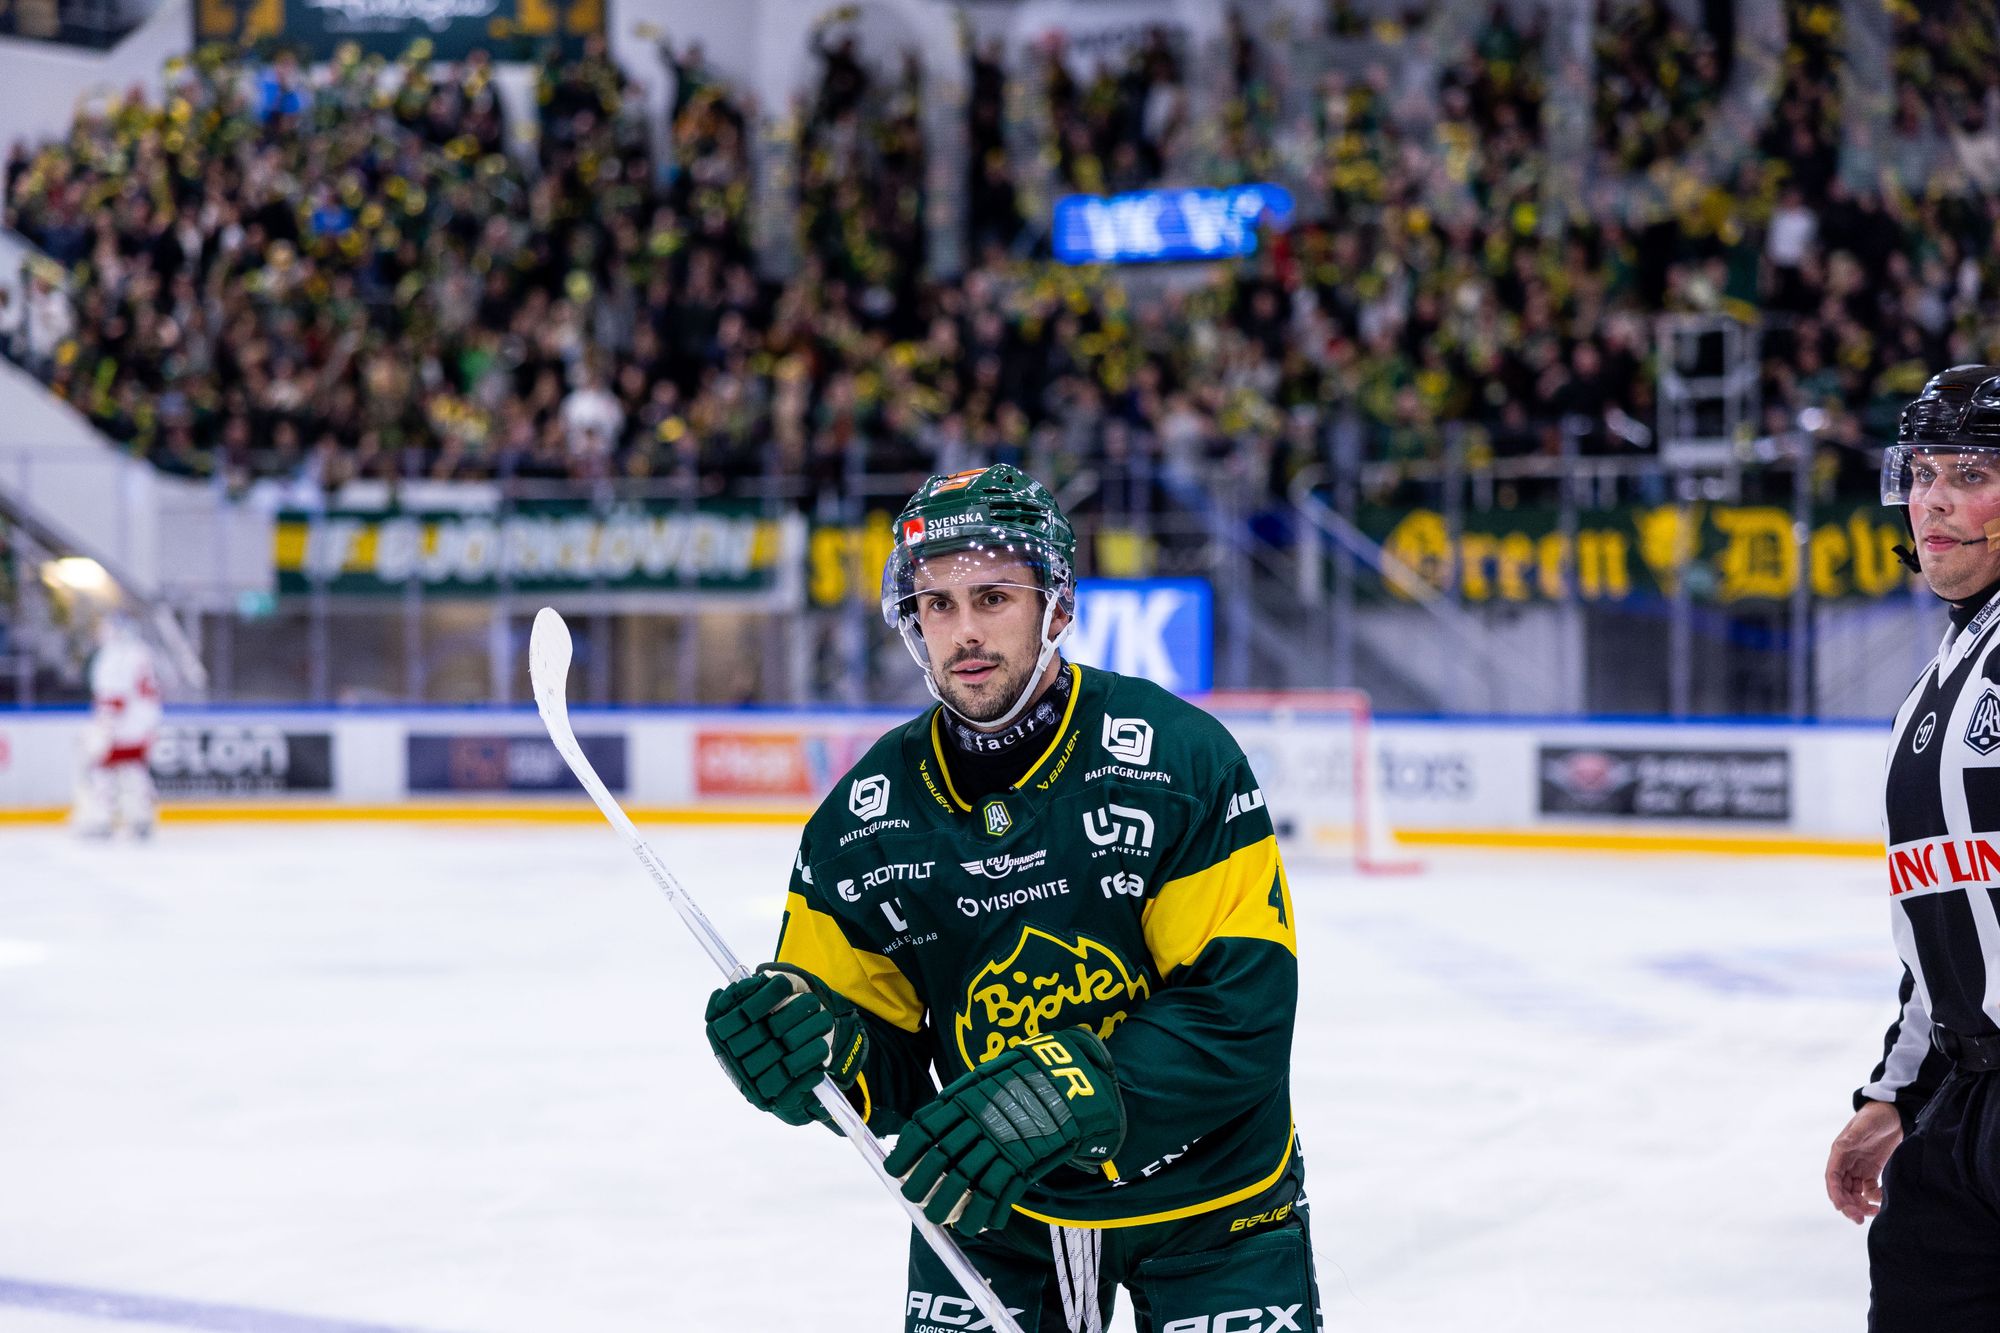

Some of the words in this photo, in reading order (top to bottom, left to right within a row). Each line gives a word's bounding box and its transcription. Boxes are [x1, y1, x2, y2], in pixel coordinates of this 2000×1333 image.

[928, 512, 983, 531] SVENSKA
[928, 527, 959, 541] SPEL
[1085, 765, 1171, 784] BALTICGRUPPEN
[1091, 849, 1107, 859] UM
[1100, 870, 1145, 899] rea
[981, 879, 1070, 912] VISIONITE
[925, 932, 938, 942] AB
